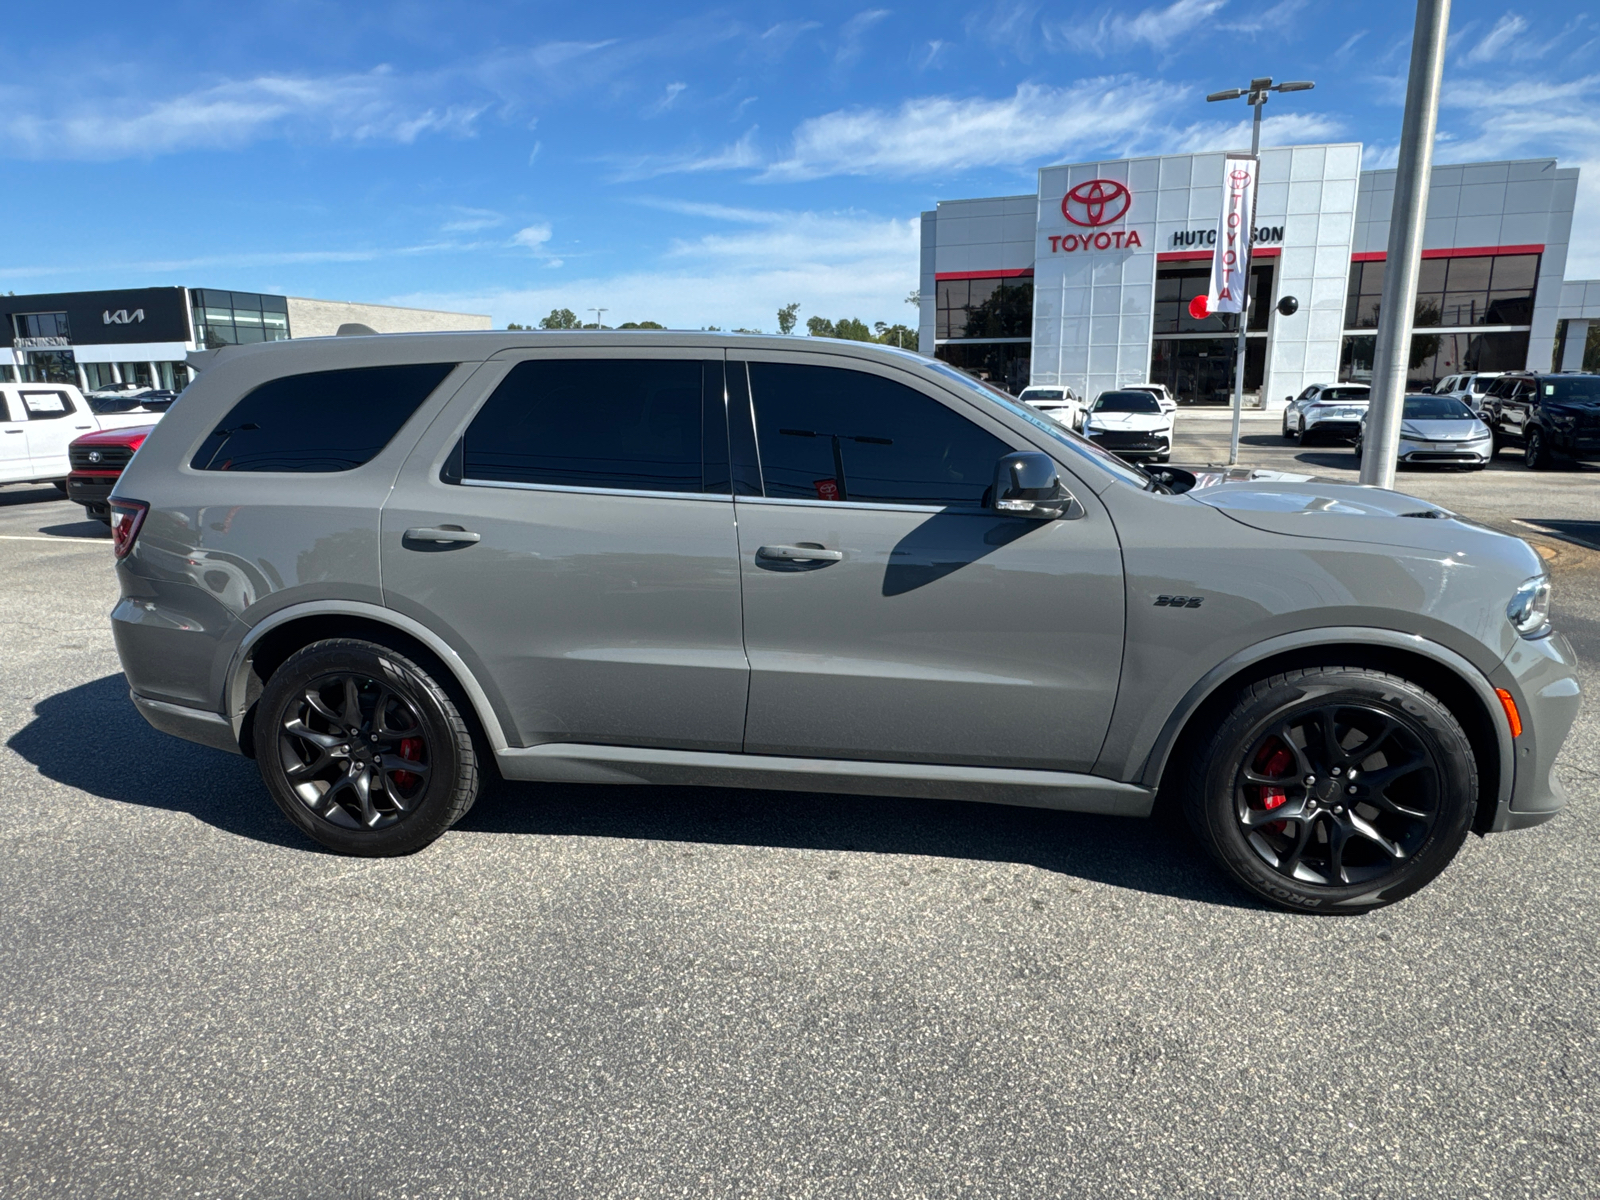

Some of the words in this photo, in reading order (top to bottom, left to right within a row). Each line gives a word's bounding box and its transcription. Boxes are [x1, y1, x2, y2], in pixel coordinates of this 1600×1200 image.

[1048, 230, 1142, 253] TOYOTA
[1173, 226, 1284, 246] HUTCSON
[1217, 194, 1241, 302] TOYOTA
